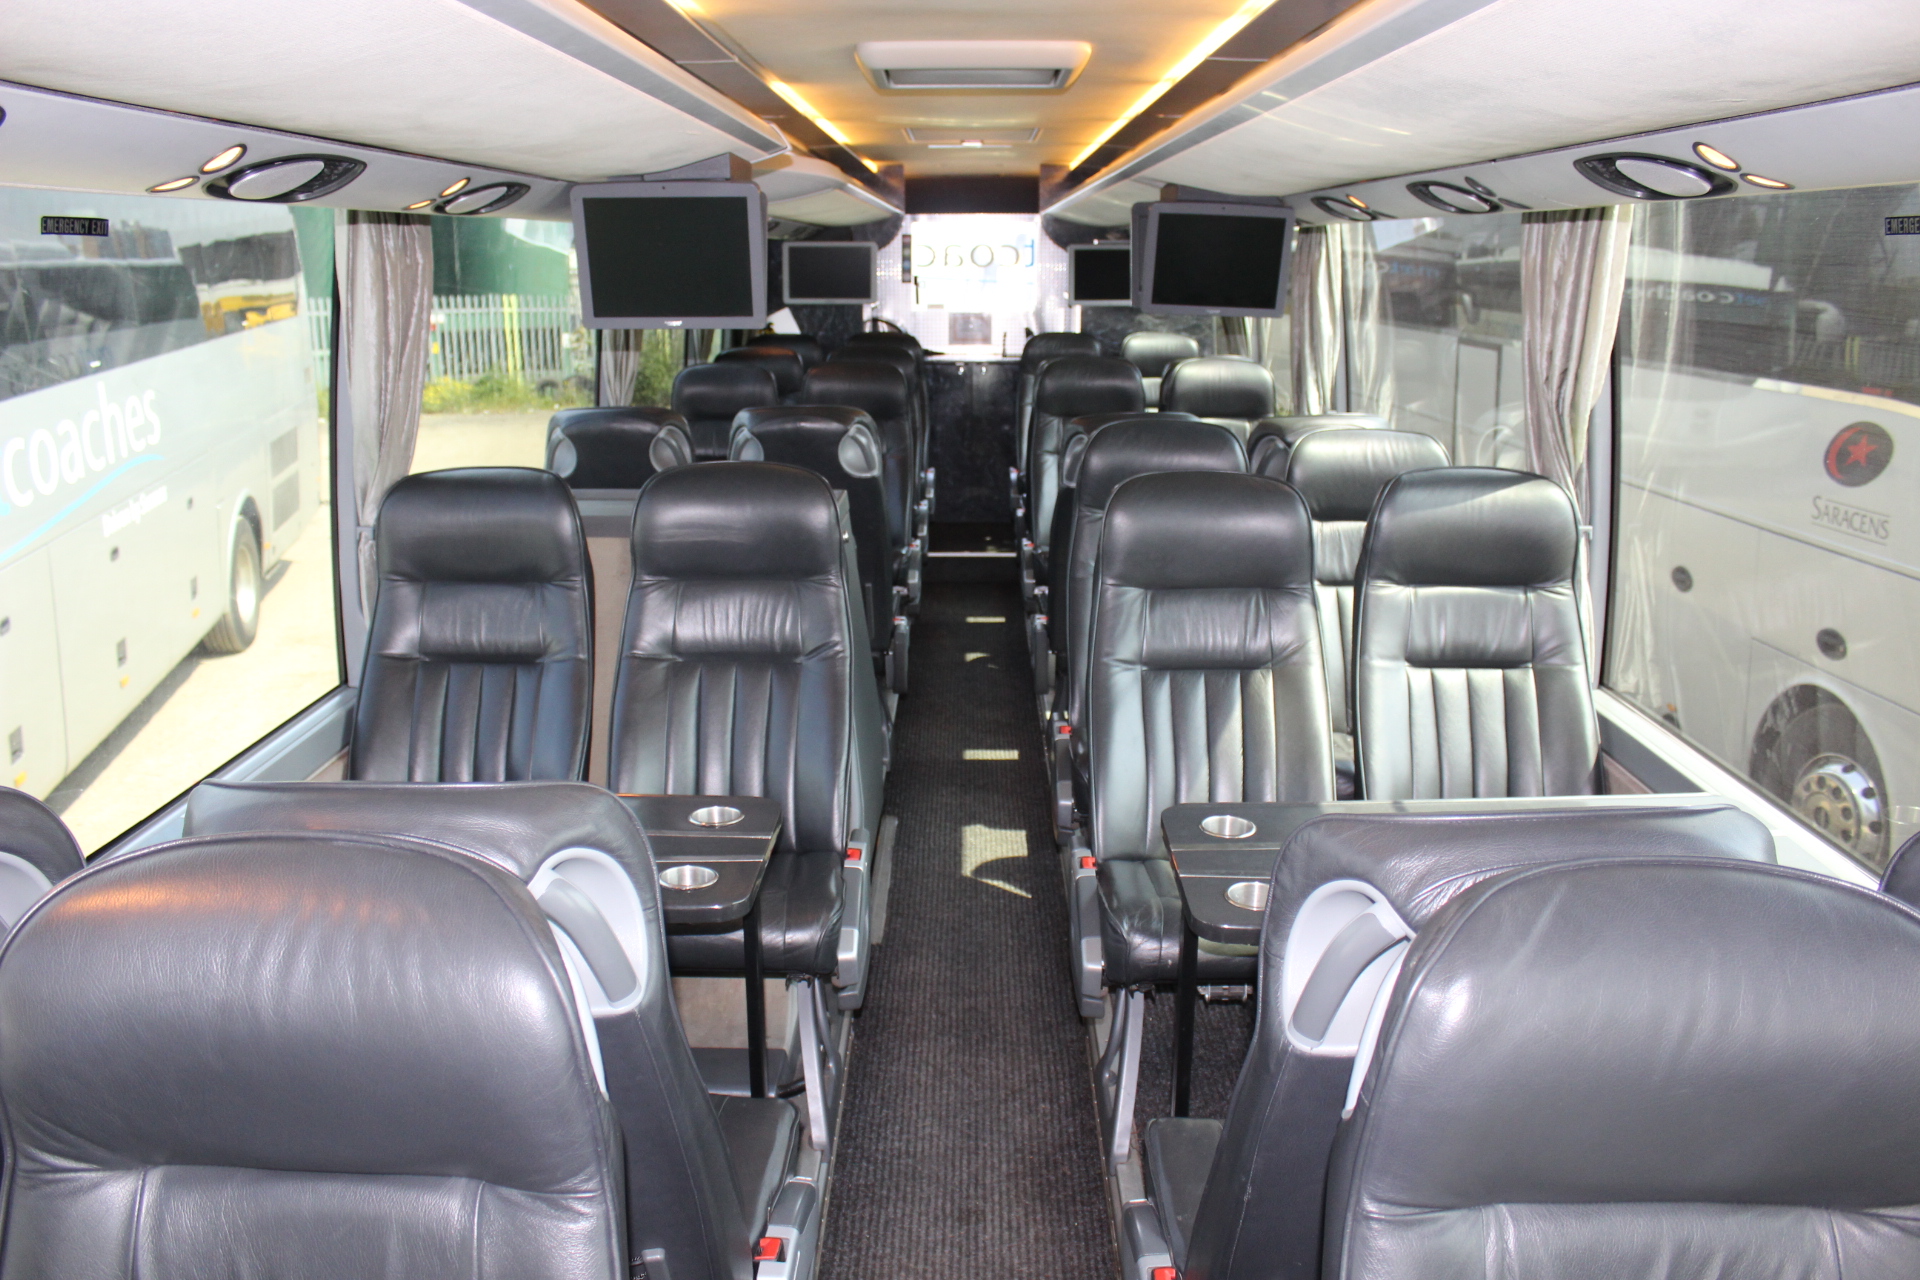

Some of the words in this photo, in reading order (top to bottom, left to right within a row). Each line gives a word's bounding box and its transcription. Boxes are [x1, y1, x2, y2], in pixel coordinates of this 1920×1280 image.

[42, 217, 89, 234] EMERGENCY
[91, 219, 107, 235] EXIT
[3, 380, 161, 507] coaches
[1811, 495, 1889, 539] SARACENS
